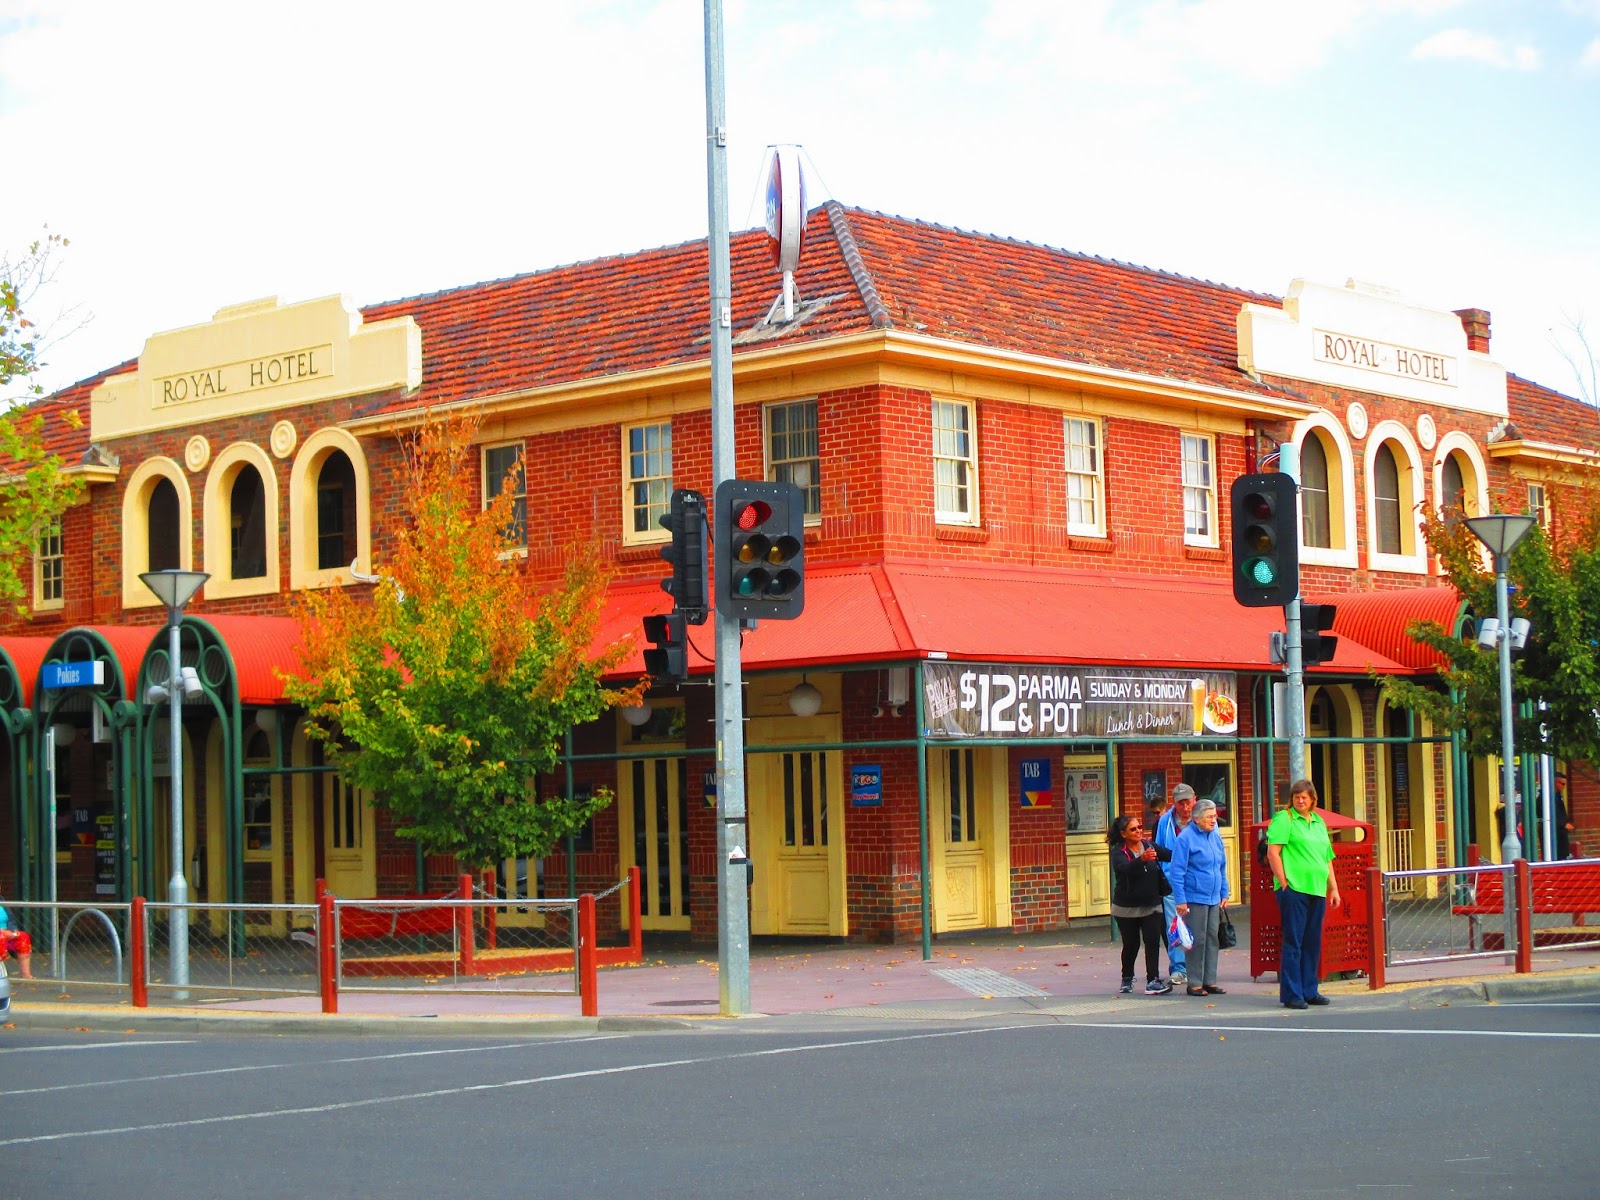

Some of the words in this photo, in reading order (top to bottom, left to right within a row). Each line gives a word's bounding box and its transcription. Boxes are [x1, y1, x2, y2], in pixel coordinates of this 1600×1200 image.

[1324, 334, 1379, 368] ROYAL
[1396, 350, 1449, 381] HOTEL
[163, 370, 227, 403] ROYAL
[250, 352, 319, 387] HOTEL
[57, 666, 80, 684] Pokies
[1018, 674, 1082, 700] PARMA
[1090, 682, 1132, 698] SUNDAY
[1134, 683, 1142, 698] &
[1144, 684, 1187, 699] MONDAY
[960, 669, 1017, 732] $12
[1018, 702, 1034, 733] &
[1039, 702, 1082, 733] POT
[1107, 711, 1135, 733] Lunch
[1136, 714, 1143, 729] &
[1145, 711, 1175, 728] Dinner
[1022, 762, 1041, 778] TAB
[1079, 779, 1102, 792] SPECIALS
[75, 809, 89, 822] TAB
